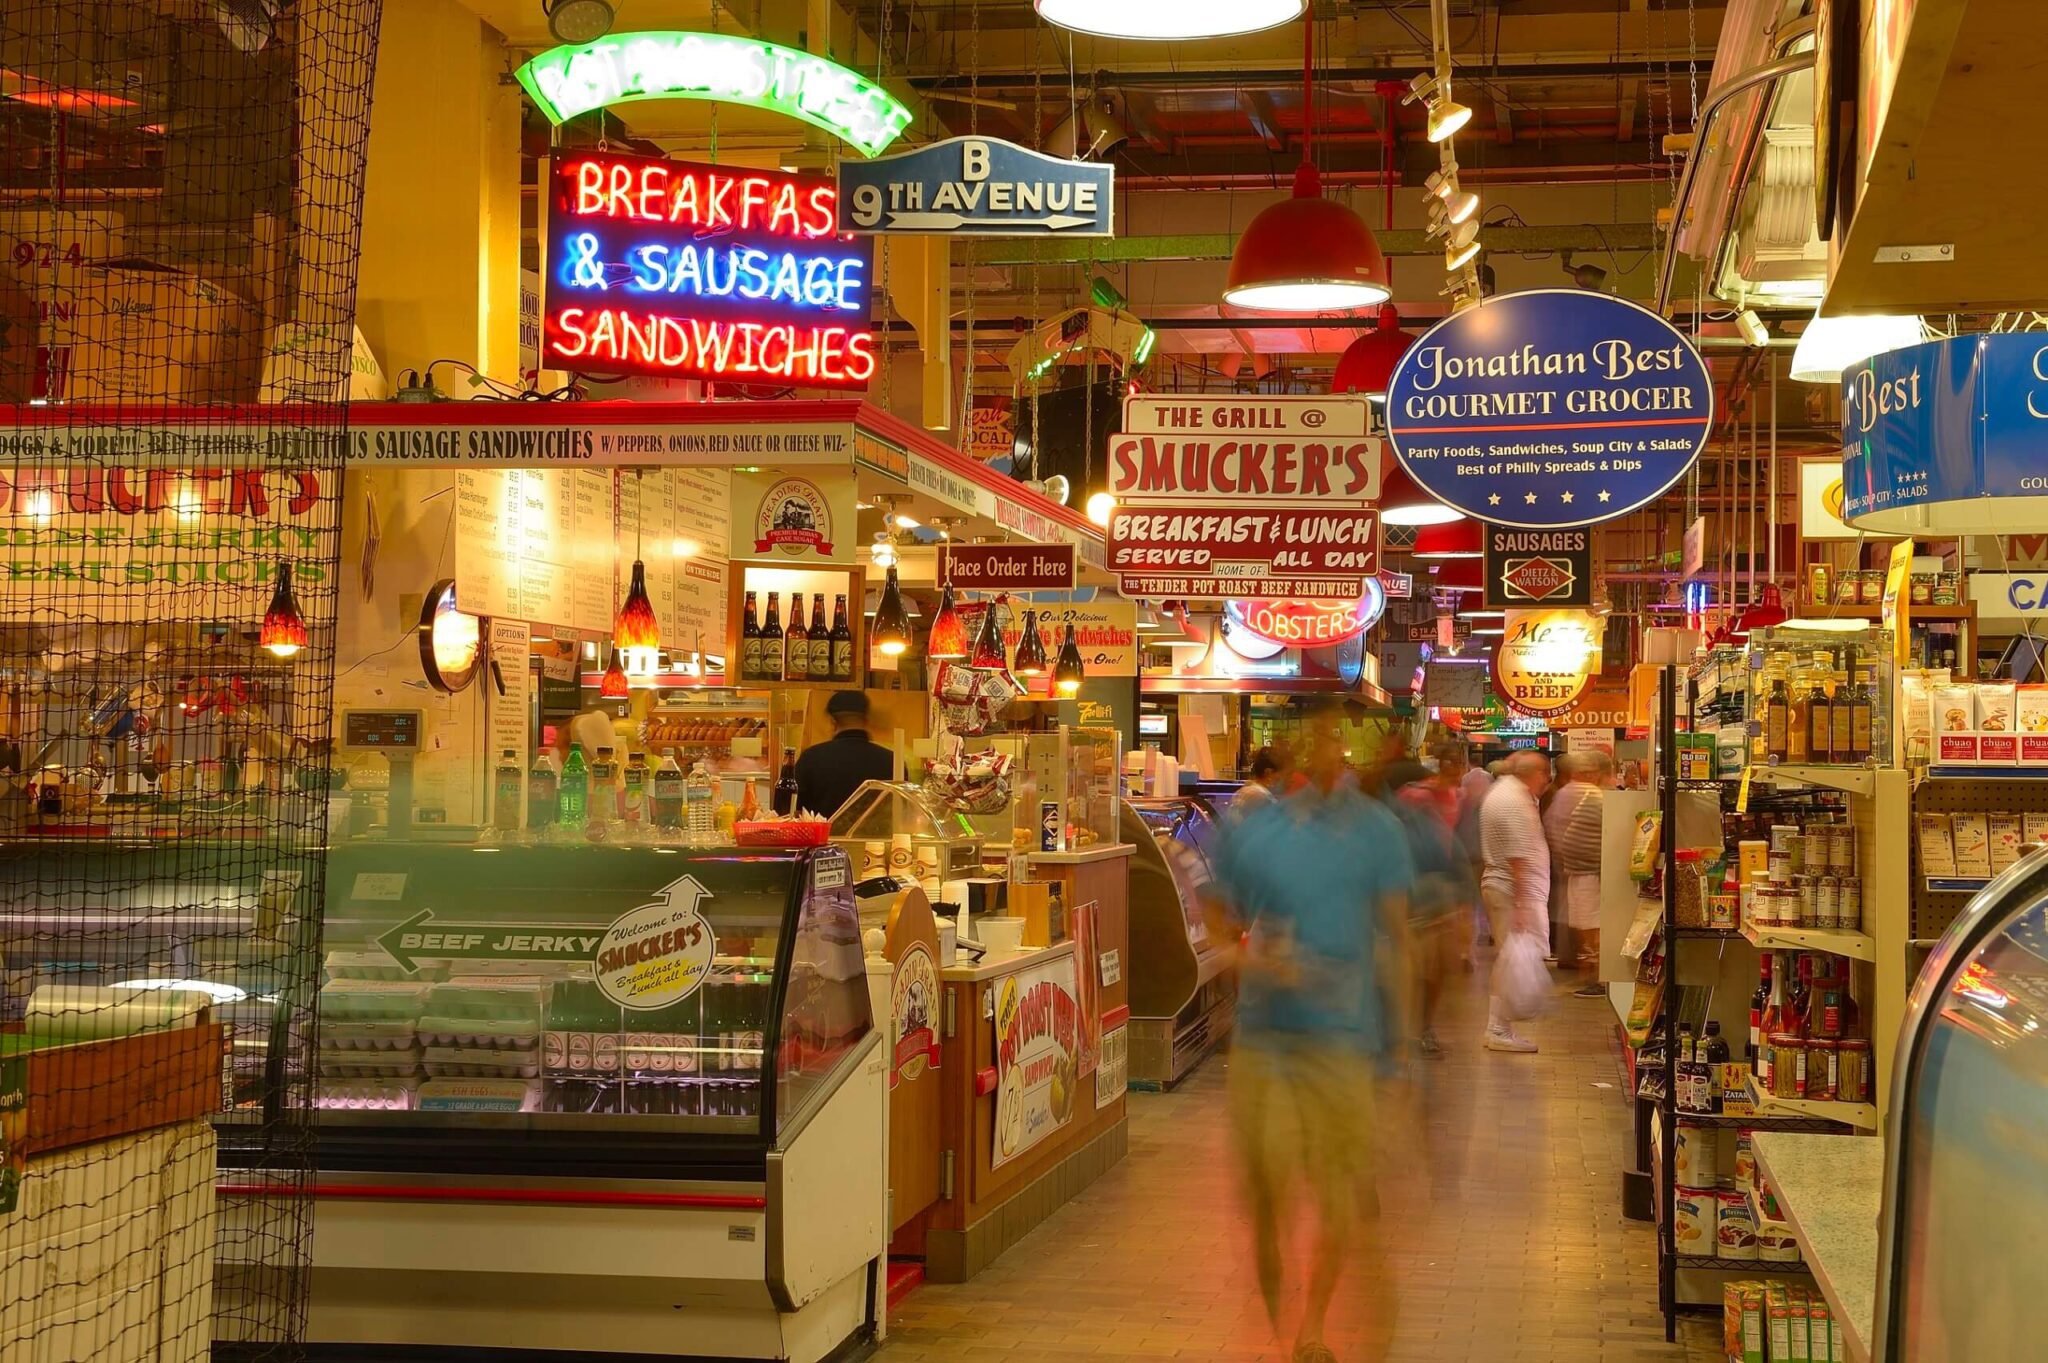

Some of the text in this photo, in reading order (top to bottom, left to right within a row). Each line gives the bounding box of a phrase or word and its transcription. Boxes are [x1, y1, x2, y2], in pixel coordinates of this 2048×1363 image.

[963, 141, 991, 182] B
[576, 160, 855, 241] BREAKFAS
[932, 182, 1099, 213] AVENUE
[574, 233, 865, 311] & SAUSAGE
[551, 308, 875, 381] SANDWICHES
[1413, 339, 1684, 391] Jonathan Best
[1405, 386, 1693, 420] GOURMET GROCER
[1855, 364, 1921, 433] Best
[1155, 407, 1327, 429] THE GRILL @
[375, 430, 461, 459] SAUSAGE
[468, 428, 594, 460] SANDWICHES
[601, 435, 615, 454] W/
[617, 435, 666, 454] PEPPERS,
[733, 435, 763, 453] SAUCE
[766, 435, 781, 453] OR
[784, 435, 820, 453] CHEESE
[963, 432, 1011, 445] OCAL
[1408, 438, 1692, 460] Party Foods, Sandwiches, Soup City & Salads
[1114, 437, 1369, 496] SMUCKER'S
[1457, 459, 1642, 476] Best of Philly Spreads & Dips
[1876, 490, 1891, 503] CITY
[1896, 484, 1929, 500] SALADS
[760, 484, 801, 527] READING
[1113, 514, 1373, 545] BREAKFAST & LUNCH
[1494, 533, 1585, 552] SAUSAGES
[944, 555, 1067, 577] Place Order Here
[1115, 548, 1211, 565] SERVED
[1272, 551, 1313, 567] ALL
[1324, 551, 1374, 568] DAY
[0, 560, 108, 582] EAT
[1217, 564, 1245, 575] HOME
[1521, 568, 1559, 577] DIETZ &
[1124, 579, 1358, 597] THE TENDER POT ROAST BEEF SANDWICH
[1515, 577, 1559, 587] WATSON
[1247, 603, 1358, 640] LOBSTERS
[496, 627, 525, 640] OPTIONS
[1515, 685, 1574, 699] BEEF
[1516, 704, 1571, 717] SINCE 1954
[1943, 738, 1972, 747] chuao
[1983, 738, 2012, 748] chuao
[611, 910, 688, 942] Welcome to:
[400, 933, 601, 953] BEEF JERKY
[598, 921, 702, 976] SMUCKER'S
[615, 959, 682, 989] Breakfast &
[626, 963, 705, 998] Lunch all day
